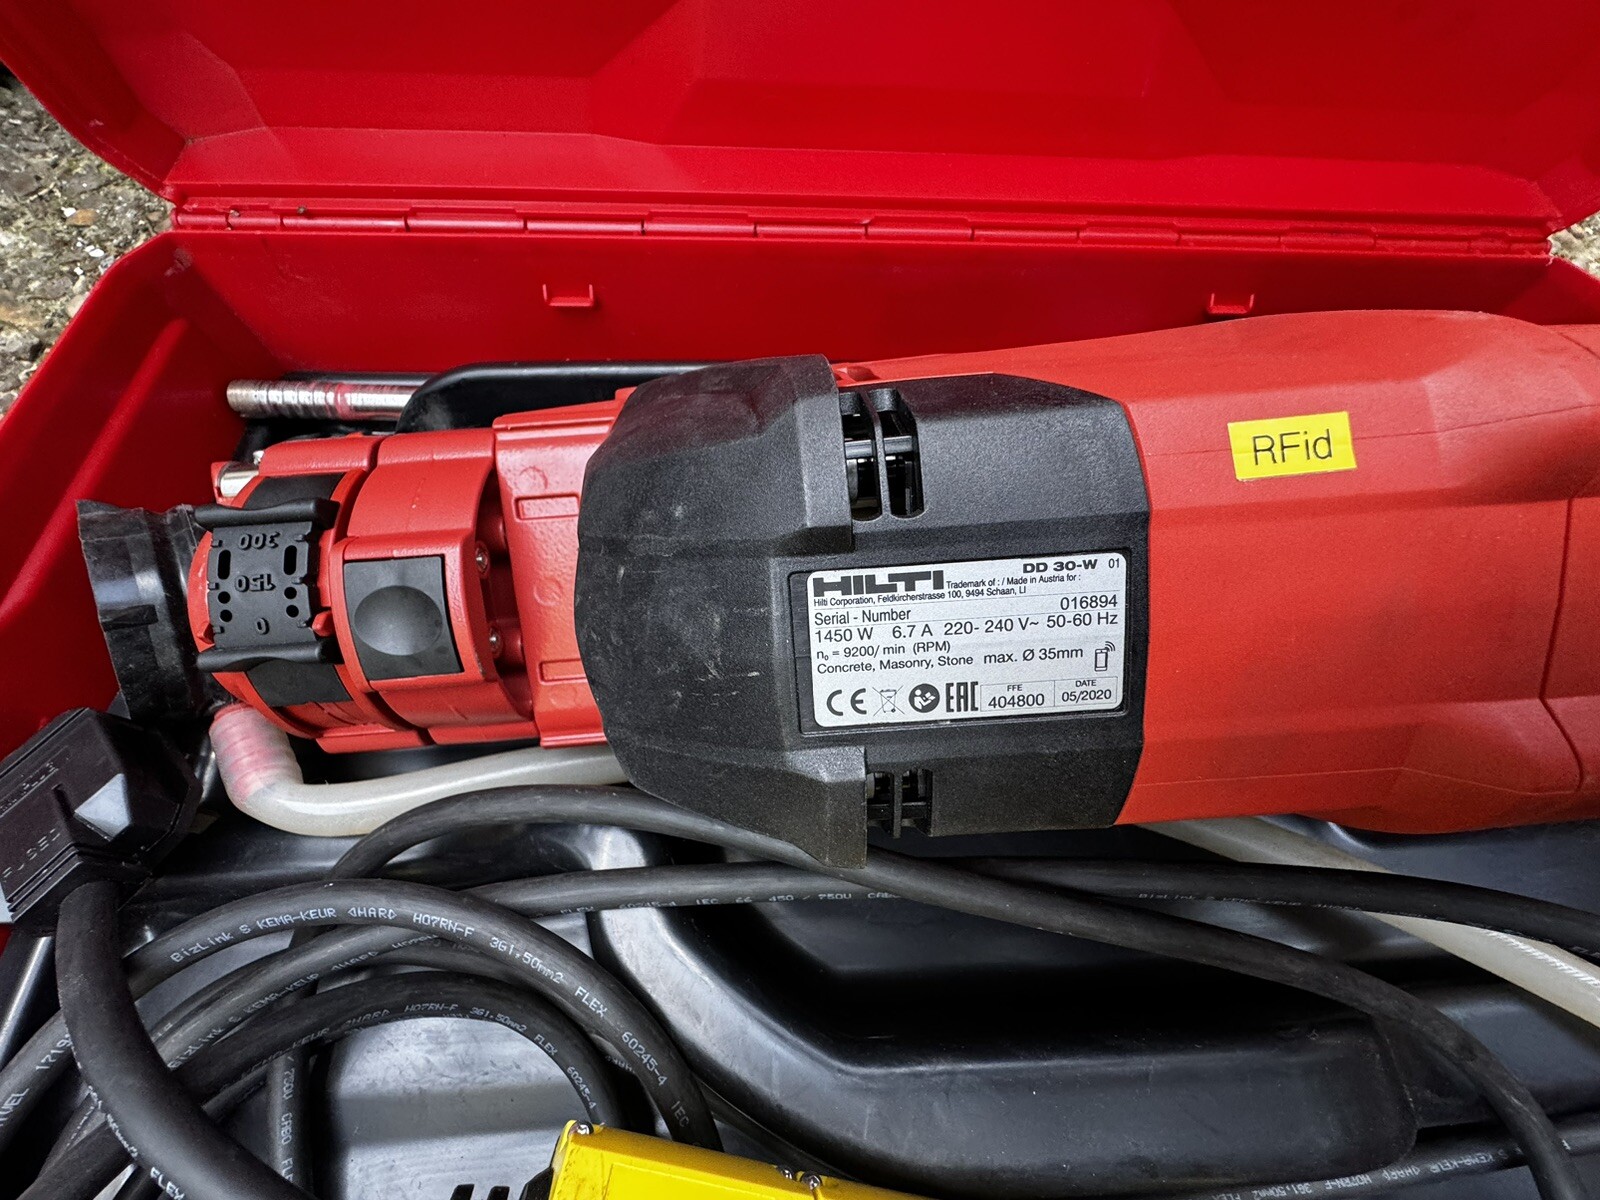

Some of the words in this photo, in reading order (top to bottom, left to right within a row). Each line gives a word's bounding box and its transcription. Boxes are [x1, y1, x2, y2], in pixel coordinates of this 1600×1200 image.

[1252, 428, 1333, 466] RFid
[238, 531, 281, 551] 300
[1022, 562, 1048, 574] DD
[1053, 559, 1098, 571] 30-W
[1108, 558, 1120, 569] 01
[235, 572, 277, 593] 150
[812, 570, 944, 598] HILTI
[946, 579, 986, 590] Trademark
[988, 578, 996, 587] of
[1007, 576, 1028, 585] Made
[1030, 575, 1037, 584] in
[1039, 573, 1065, 583] Austria
[1066, 572, 1077, 582] for
[813, 598, 828, 607] Hilti
[829, 596, 876, 607] Corporation,
[877, 591, 946, 603] Feldkircherstrasse
[947, 590, 964, 599] 100,
[965, 589, 985, 598] 9494
[986, 587, 1017, 597] Schaan,
[814, 611, 850, 626] Serial
[862, 608, 912, 623] Number
[1060, 594, 1118, 611] 016894
[815, 628, 853, 643] 1450
[857, 627, 873, 641] W
[892, 624, 916, 639] 6.7
[921, 624, 933, 637] A
[985, 618, 1014, 633] 240
[1046, 613, 1092, 629] 50-60
[1097, 612, 1118, 626] Hz
[883, 644, 906, 655] min
[912, 641, 951, 656] (RPM)
[817, 662, 876, 674] Concrete,
[879, 659, 934, 671] Masonry,
[938, 655, 974, 667] Stone
[984, 653, 1018, 664] max.
[1039, 648, 1084, 660] 35mm
[1007, 684, 1023, 692] FFE
[1075, 680, 1097, 688] DATE
[988, 693, 1045, 709] 404800
[1061, 689, 1112, 704] 05/2020
[170, 931, 234, 963] BizLink
[256, 907, 337, 930] KEMA-KEUR
[574, 985, 608, 1019] FLEX
[621, 1031, 668, 1087] 60245-4
[671, 1100, 690, 1128] IEC
[533, 1033, 559, 1057] FLEX
[566, 1065, 597, 1110] 60245-4
